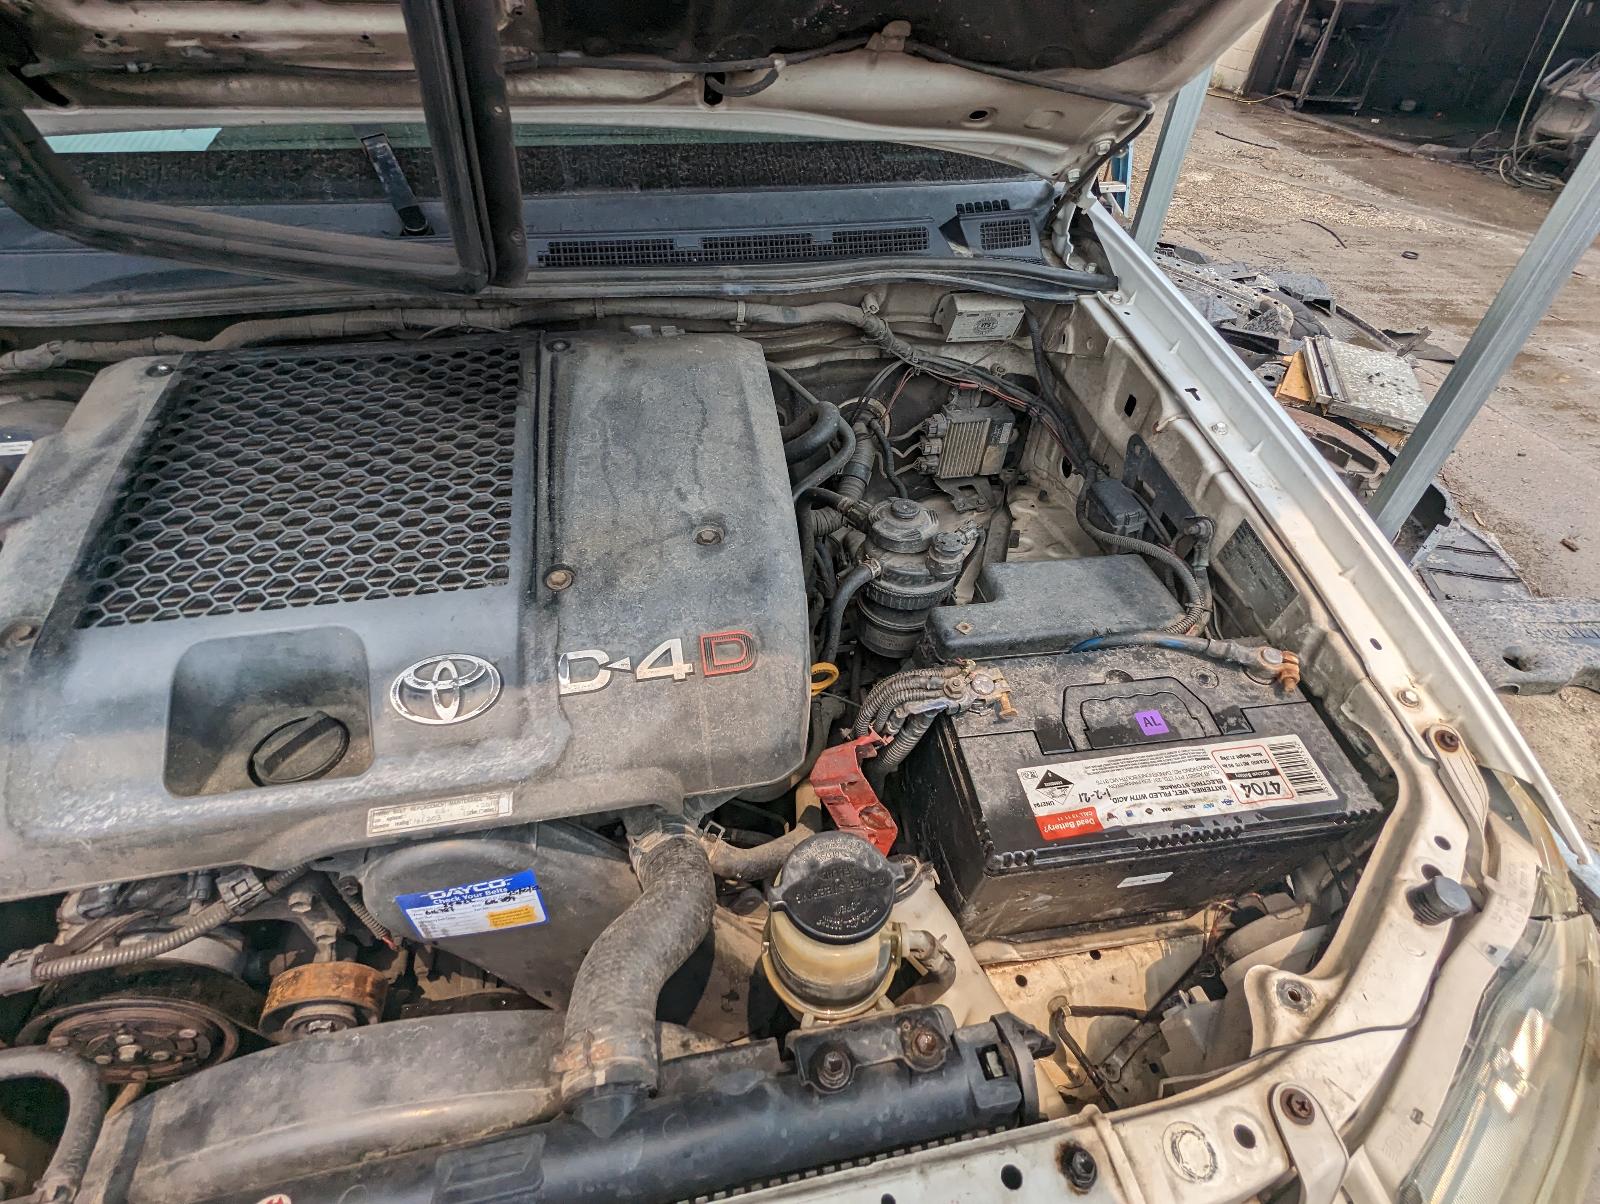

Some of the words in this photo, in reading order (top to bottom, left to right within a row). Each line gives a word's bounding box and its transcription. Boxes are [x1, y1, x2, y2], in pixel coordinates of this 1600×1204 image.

[1143, 715, 1162, 727] AL
[1190, 778, 1224, 787] ELECTRIC
[1192, 785, 1227, 794] BATTERIES,
[1240, 781, 1281, 798] 4704
[1110, 796, 1129, 804] ACID,
[1149, 791, 1172, 799] FILLED
[1044, 821, 1075, 832] Battery?
[1077, 818, 1096, 827] Dead
[427, 878, 508, 900] DAYCO
[433, 894, 461, 905] Check
[463, 890, 484, 901] Your
[485, 886, 508, 896] Belts
